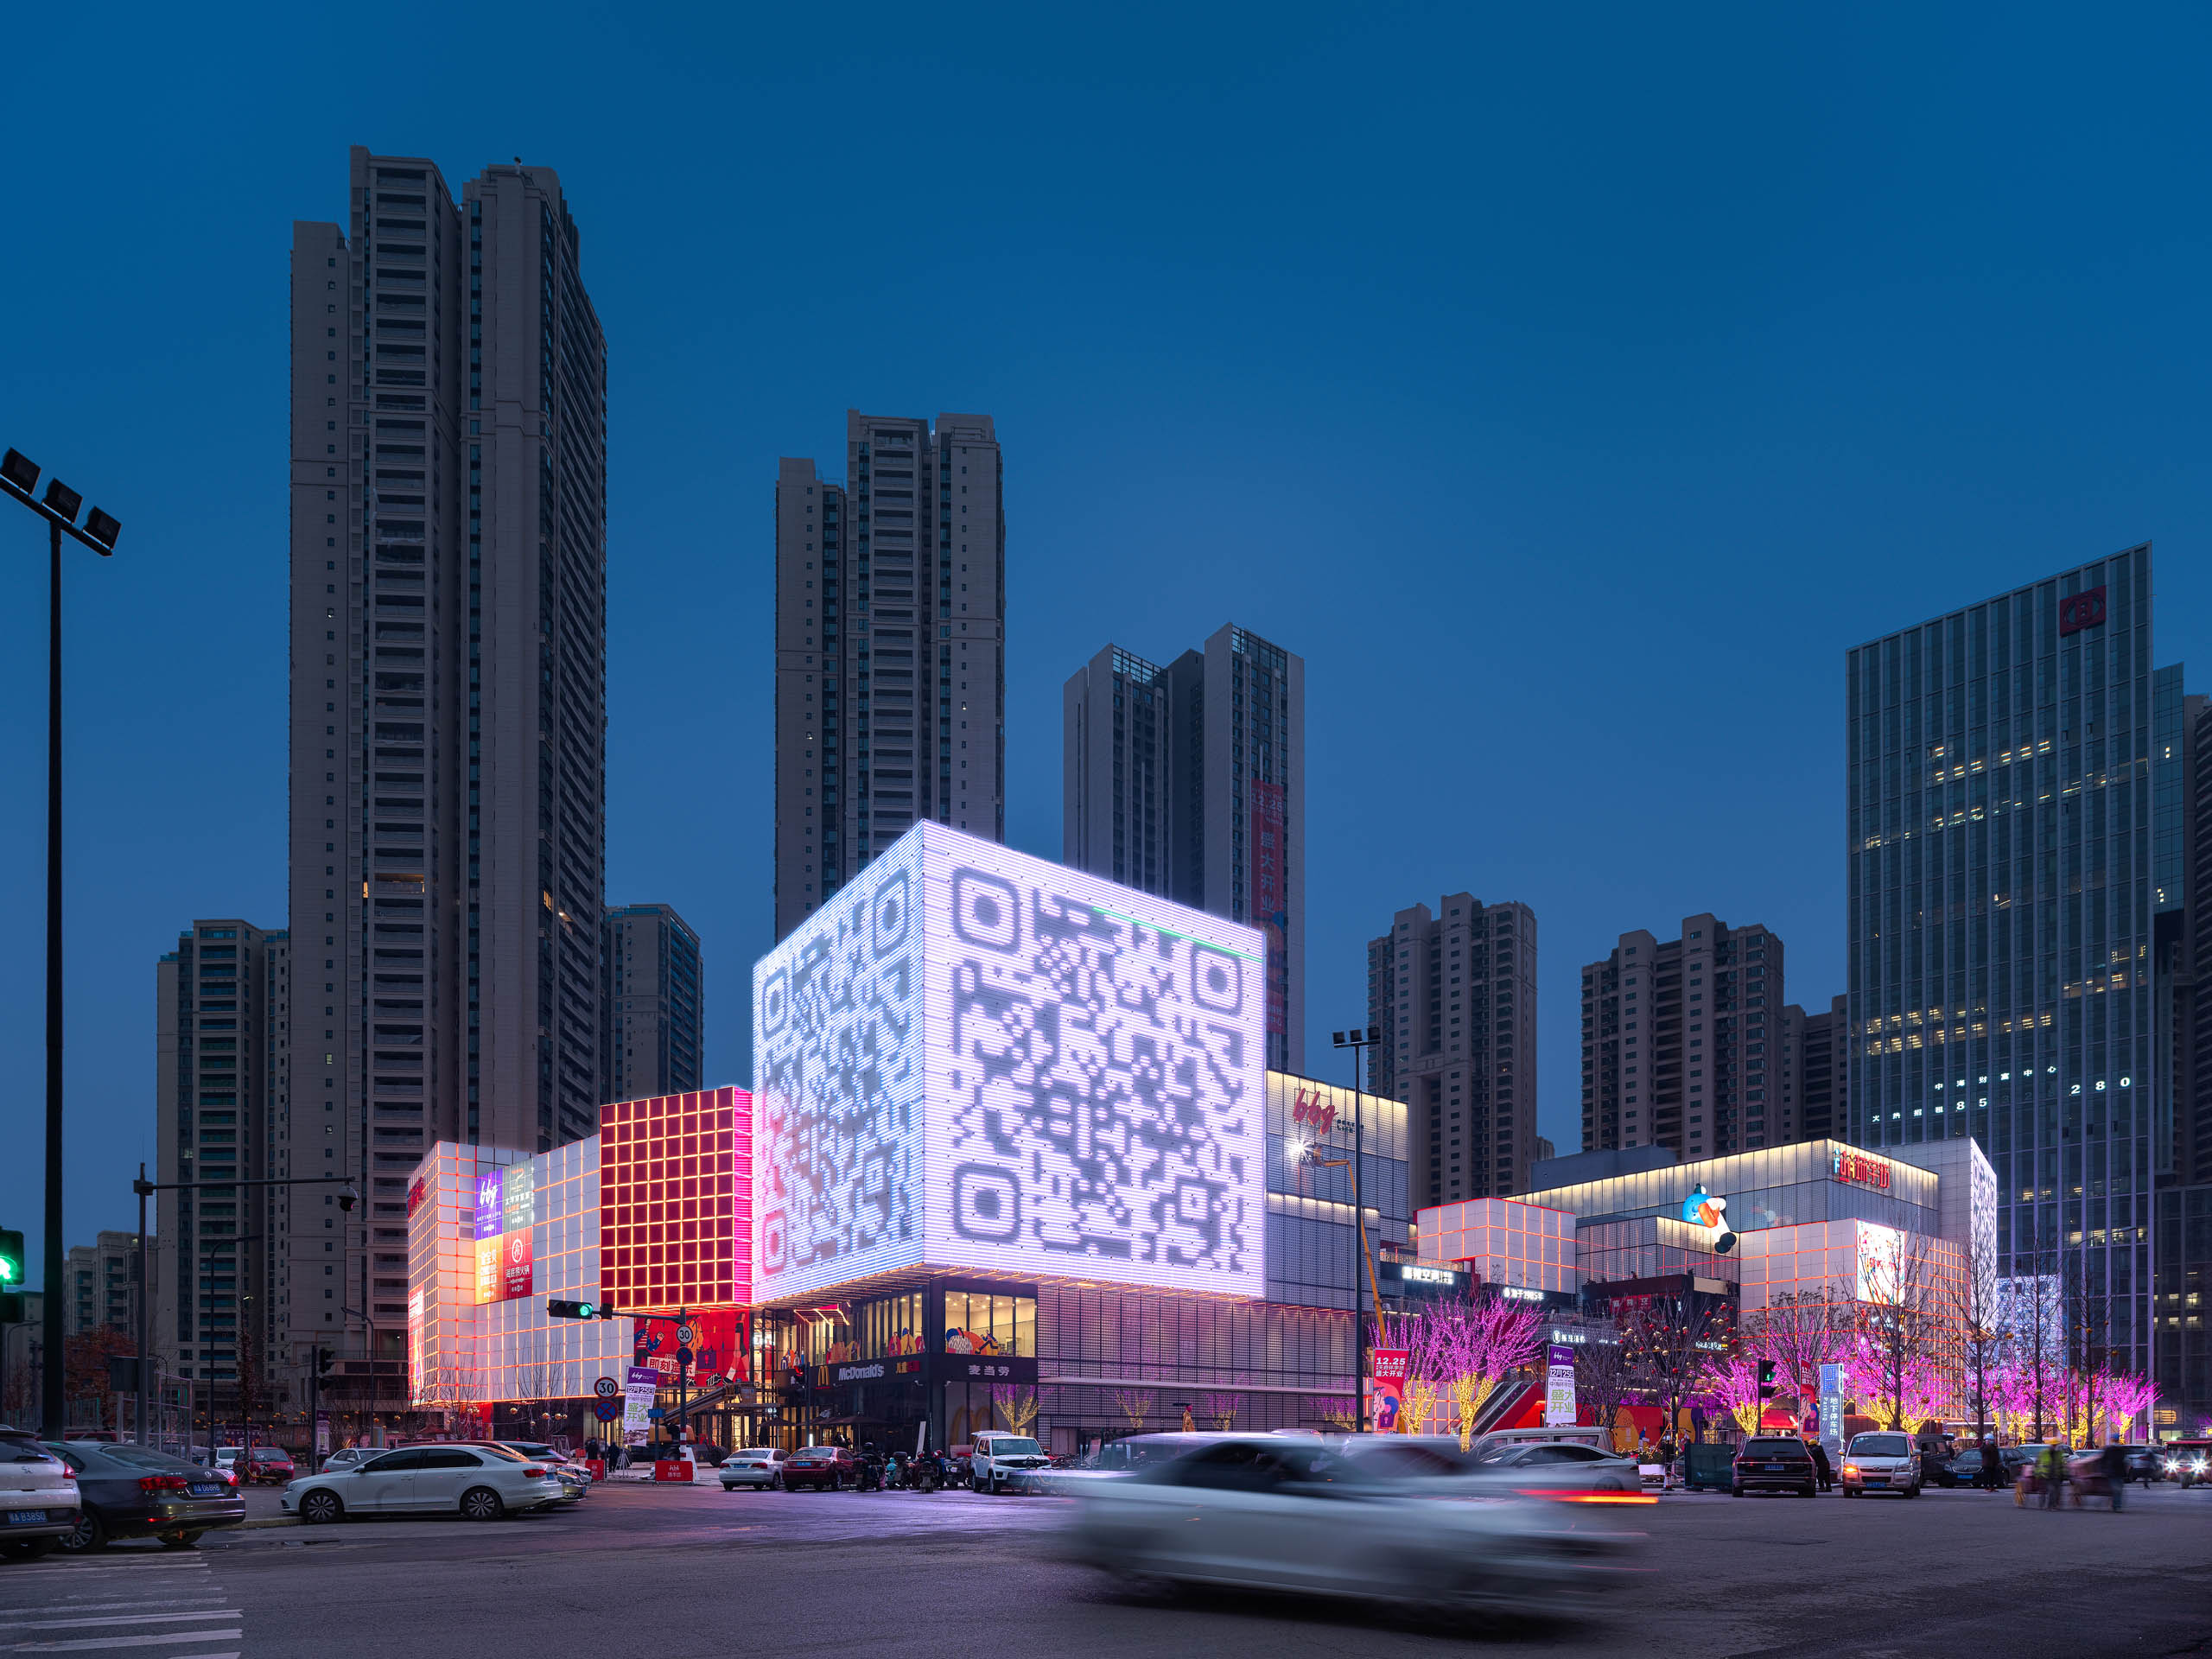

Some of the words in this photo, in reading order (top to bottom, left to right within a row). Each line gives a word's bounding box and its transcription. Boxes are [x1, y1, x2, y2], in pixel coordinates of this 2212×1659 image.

[1261, 832, 1274, 912] 盛大开业
[680, 1331, 690, 1339] 30
[1376, 1357, 1406, 1365] 12.25
[838, 1364, 885, 1381] McDonald's
[968, 1364, 1010, 1376] 麦当劳
[599, 1382, 614, 1394] 30
[1551, 1389, 1573, 1402] 盛大
[1550, 1402, 1574, 1413] 开业
[1830, 1396, 1839, 1436] 地下停车场
